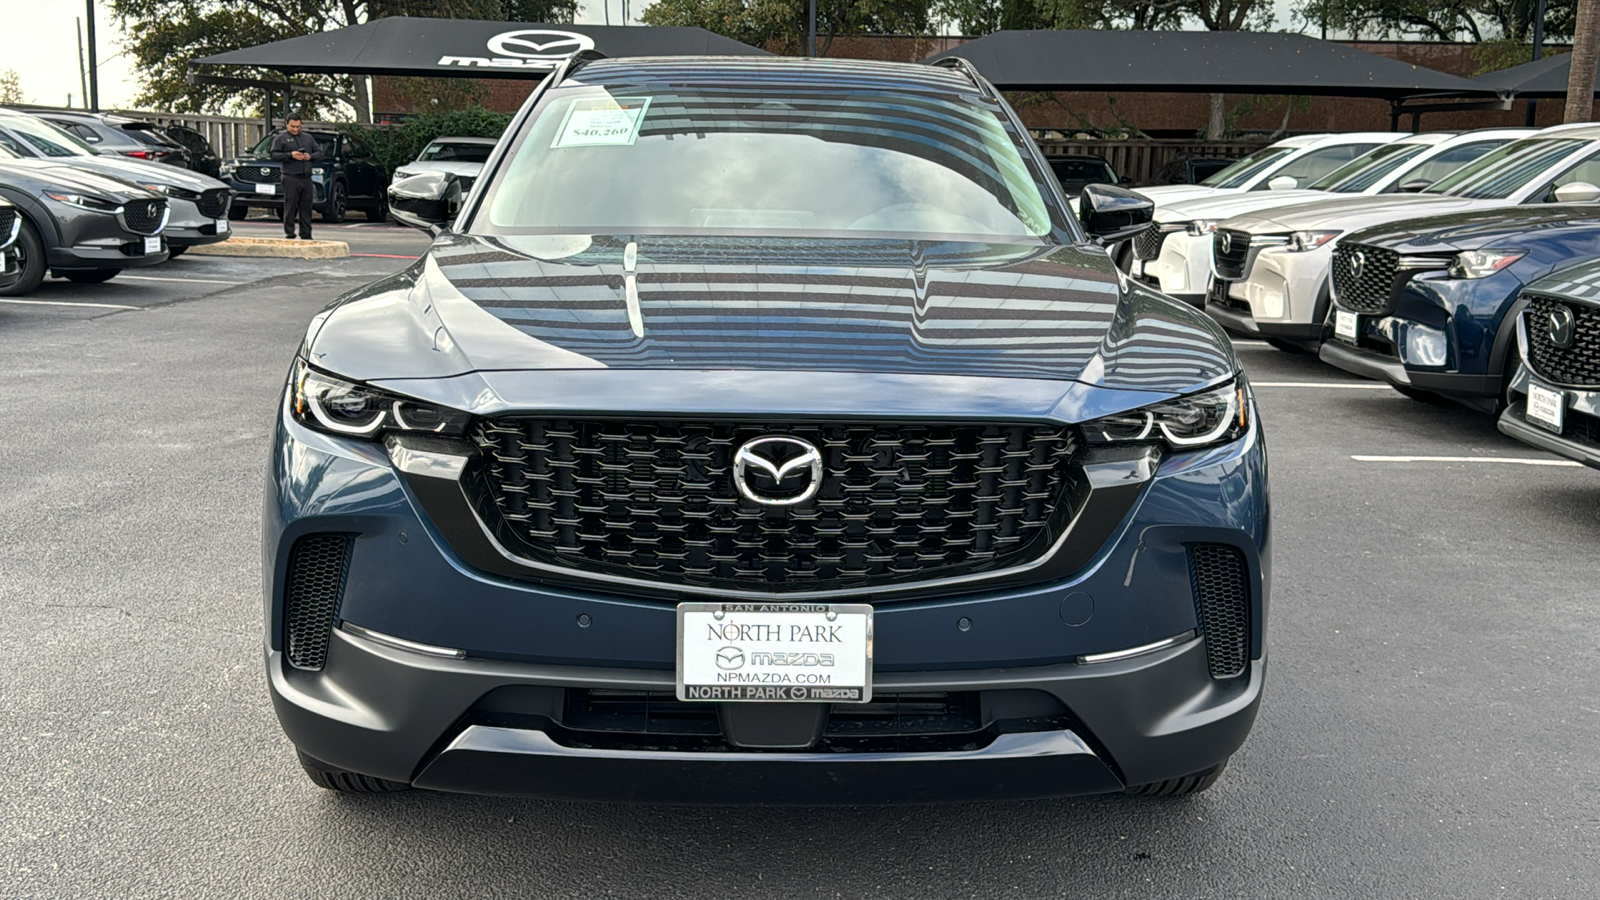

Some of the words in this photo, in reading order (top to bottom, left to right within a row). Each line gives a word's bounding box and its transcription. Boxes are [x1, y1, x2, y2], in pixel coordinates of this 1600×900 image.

[437, 55, 565, 69] maz
[573, 127, 628, 137] $40,260
[762, 605, 825, 613] ANTONIO
[707, 623, 781, 642] NORTH
[790, 625, 843, 643] PARK
[751, 651, 834, 667] mazda
[717, 672, 831, 684] NPMAZDA.COM
[689, 686, 741, 699] NORTH
[747, 687, 787, 699] PARK
[810, 688, 859, 699] mazda
